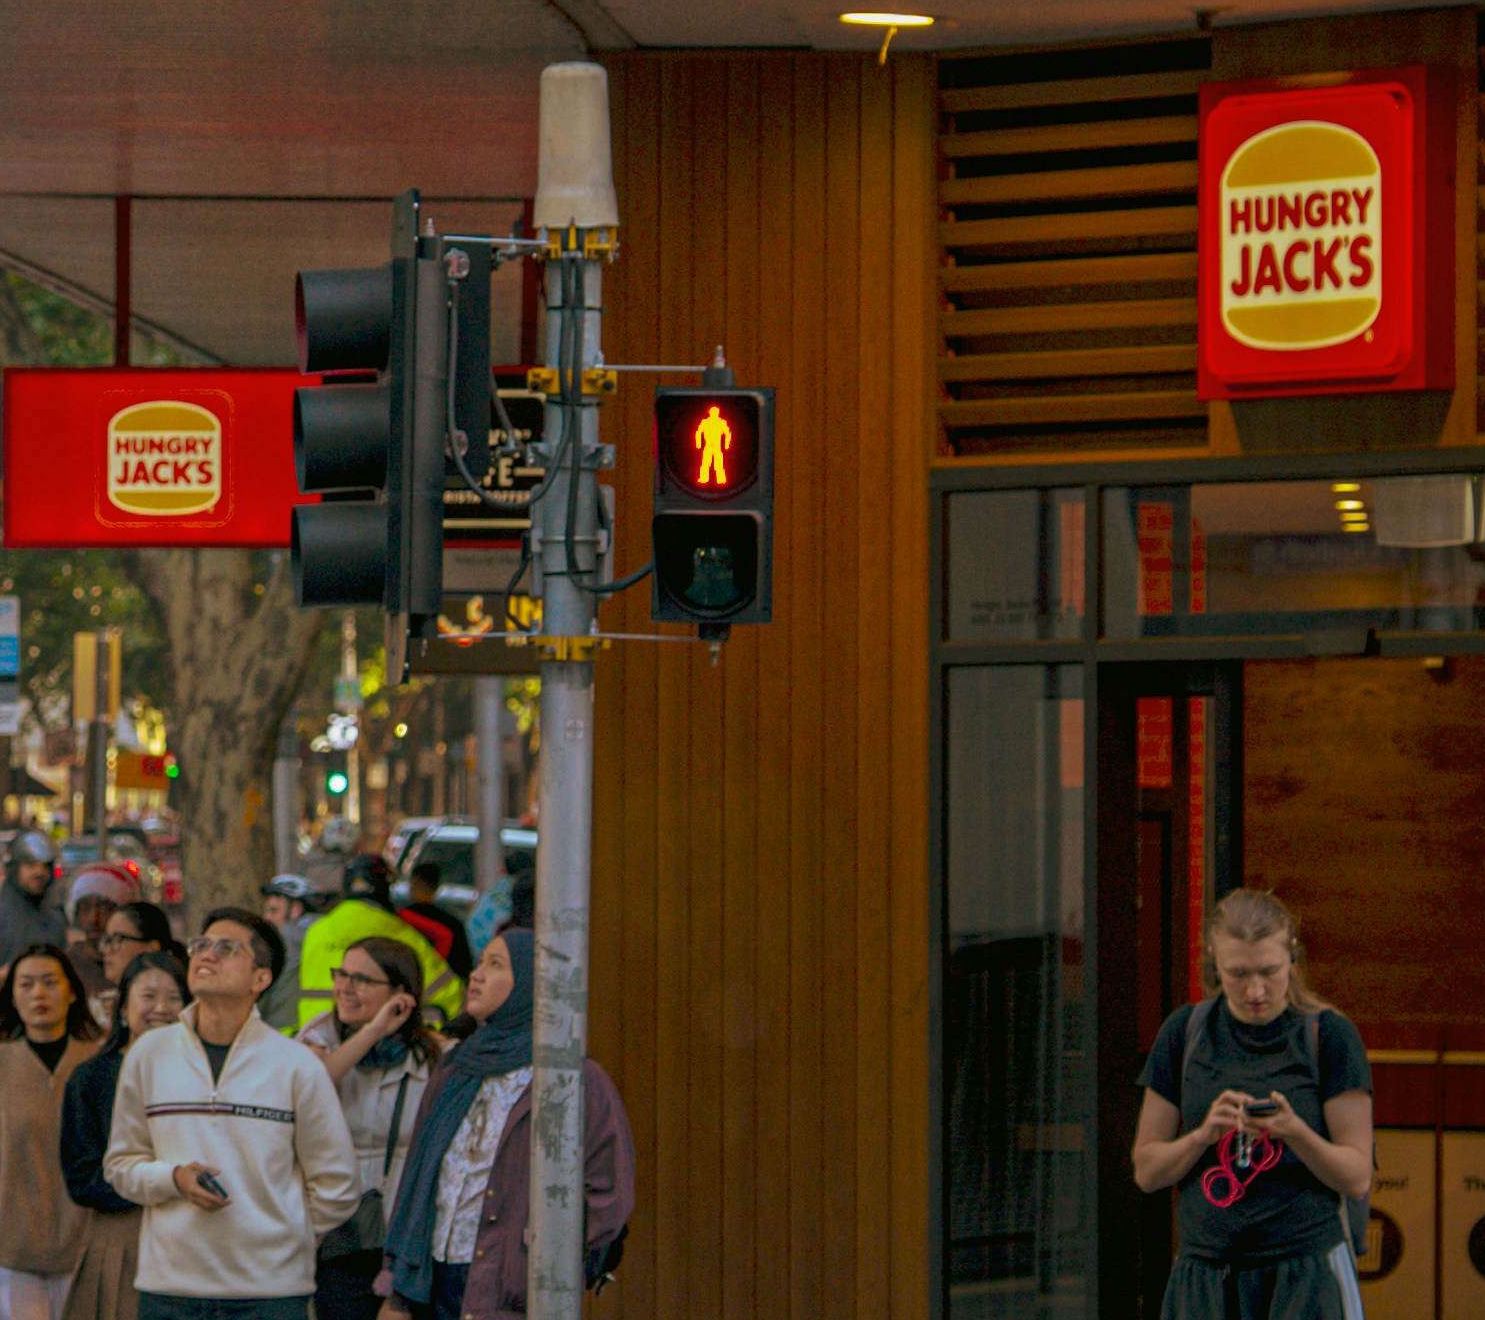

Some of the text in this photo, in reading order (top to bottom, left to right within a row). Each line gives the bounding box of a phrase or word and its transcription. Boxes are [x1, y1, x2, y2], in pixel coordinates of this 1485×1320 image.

[1230, 187, 1374, 235] HUNGRY
[1230, 237, 1374, 297] JACK'S
[114, 434, 214, 458] HUNGRY
[115, 458, 214, 487] JACK'S
[235, 1105, 293, 1123] HILFIGER
